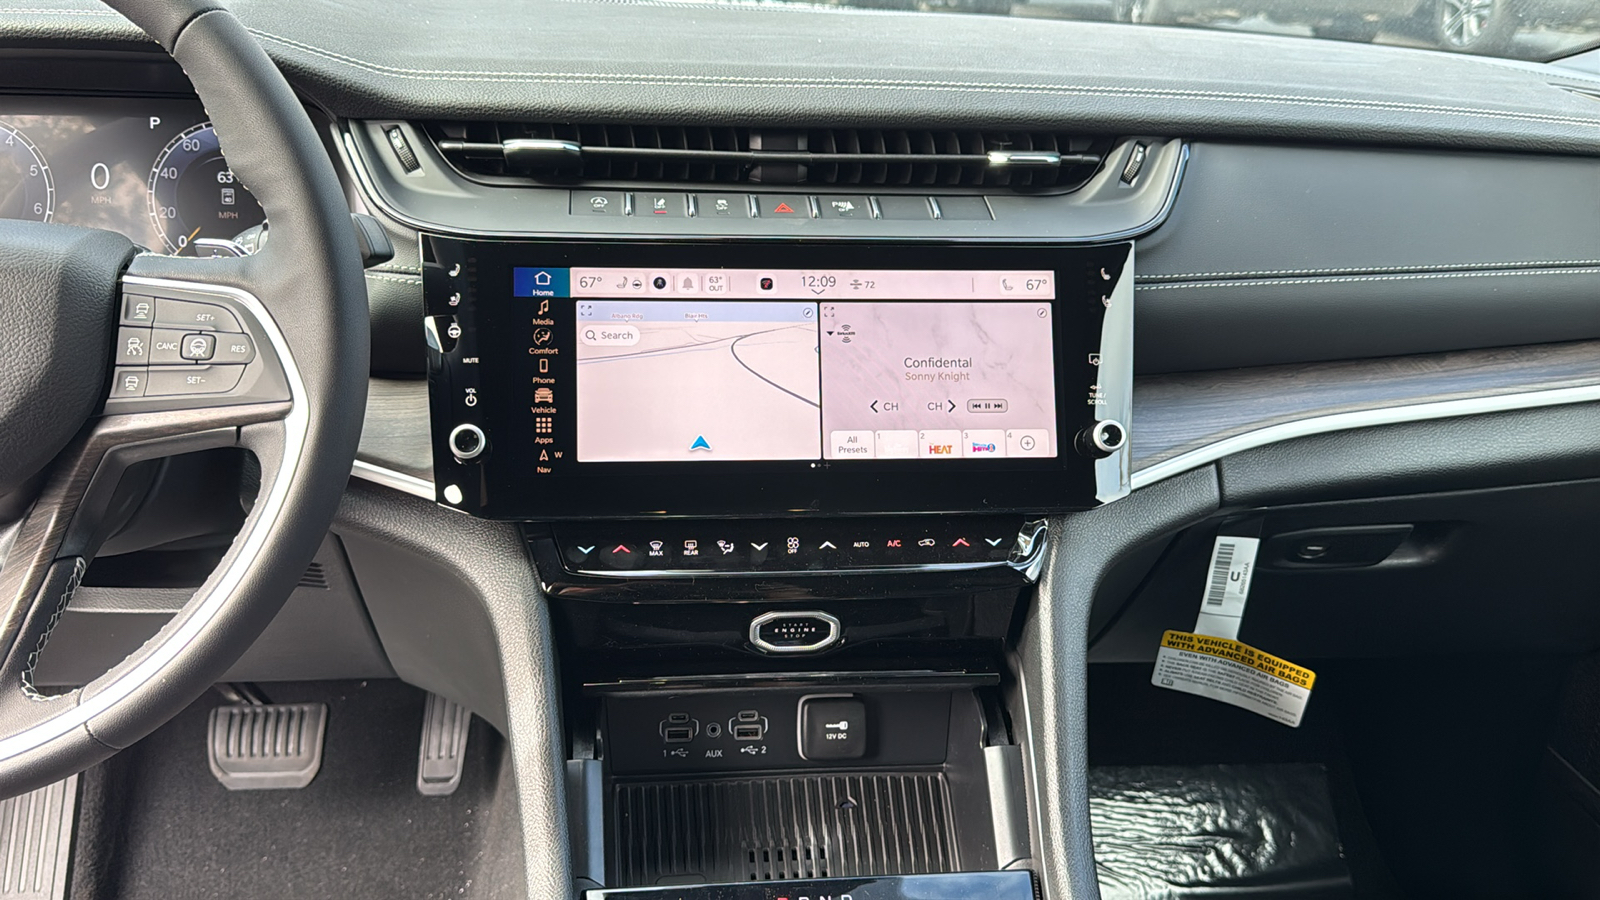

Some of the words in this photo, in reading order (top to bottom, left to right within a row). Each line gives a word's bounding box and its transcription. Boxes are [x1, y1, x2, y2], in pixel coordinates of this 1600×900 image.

[150, 117, 160, 129] P
[5, 135, 14, 146] 4
[183, 139, 200, 151] 60
[30, 164, 38, 176] 5
[160, 167, 177, 179] 40
[90, 162, 110, 190] 0
[217, 171, 234, 183] 63
[90, 196, 112, 204] MPH
[33, 202, 42, 214] 6
[159, 206, 176, 218] 20
[218, 211, 238, 219] MPH
[178, 235, 188, 247] 0
[579, 276, 603, 289] 67°
[708, 276, 723, 284] 63°
[801, 275, 837, 288] 12:09
[864, 281, 876, 289] 72
[1025, 279, 1048, 291] 67°
[532, 289, 554, 297] Home
[532, 318, 554, 326] Media
[601, 331, 633, 340] Search
[156, 342, 178, 351] CANC
[230, 344, 246, 353] RES
[528, 347, 559, 355] Comfort
[903, 357, 973, 369] Confidental
[532, 376, 556, 385] Phone
[904, 371, 936, 383] Sonny
[938, 371, 970, 382] Knight
[530, 406, 557, 414] Vehicle
[883, 402, 899, 412] CH
[927, 402, 943, 412] CH
[534, 436, 554, 445] Apps
[847, 436, 858, 444] All
[963, 432, 969, 440] 3
[838, 445, 868, 455] Presets
[929, 445, 952, 455] HEAT
[536, 466, 552, 474] Nav
[1169, 633, 1194, 643] THIS
[1196, 637, 1242, 652] VEHICLE
[1244, 647, 1255, 658] IS
[1257, 653, 1310, 679] EQUIPPED
[1167, 640, 1195, 650] WITH
[1197, 645, 1255, 665] ADVANCED
[1257, 662, 1276, 674] AIR
[1278, 670, 1308, 687] BAGS
[1199, 655, 1217, 663] WITH
[1218, 659, 1256, 675] ADVANCED
[1269, 677, 1289, 689] BAGS
[705, 749, 723, 758] AUX
[761, 746, 767, 754] 2
